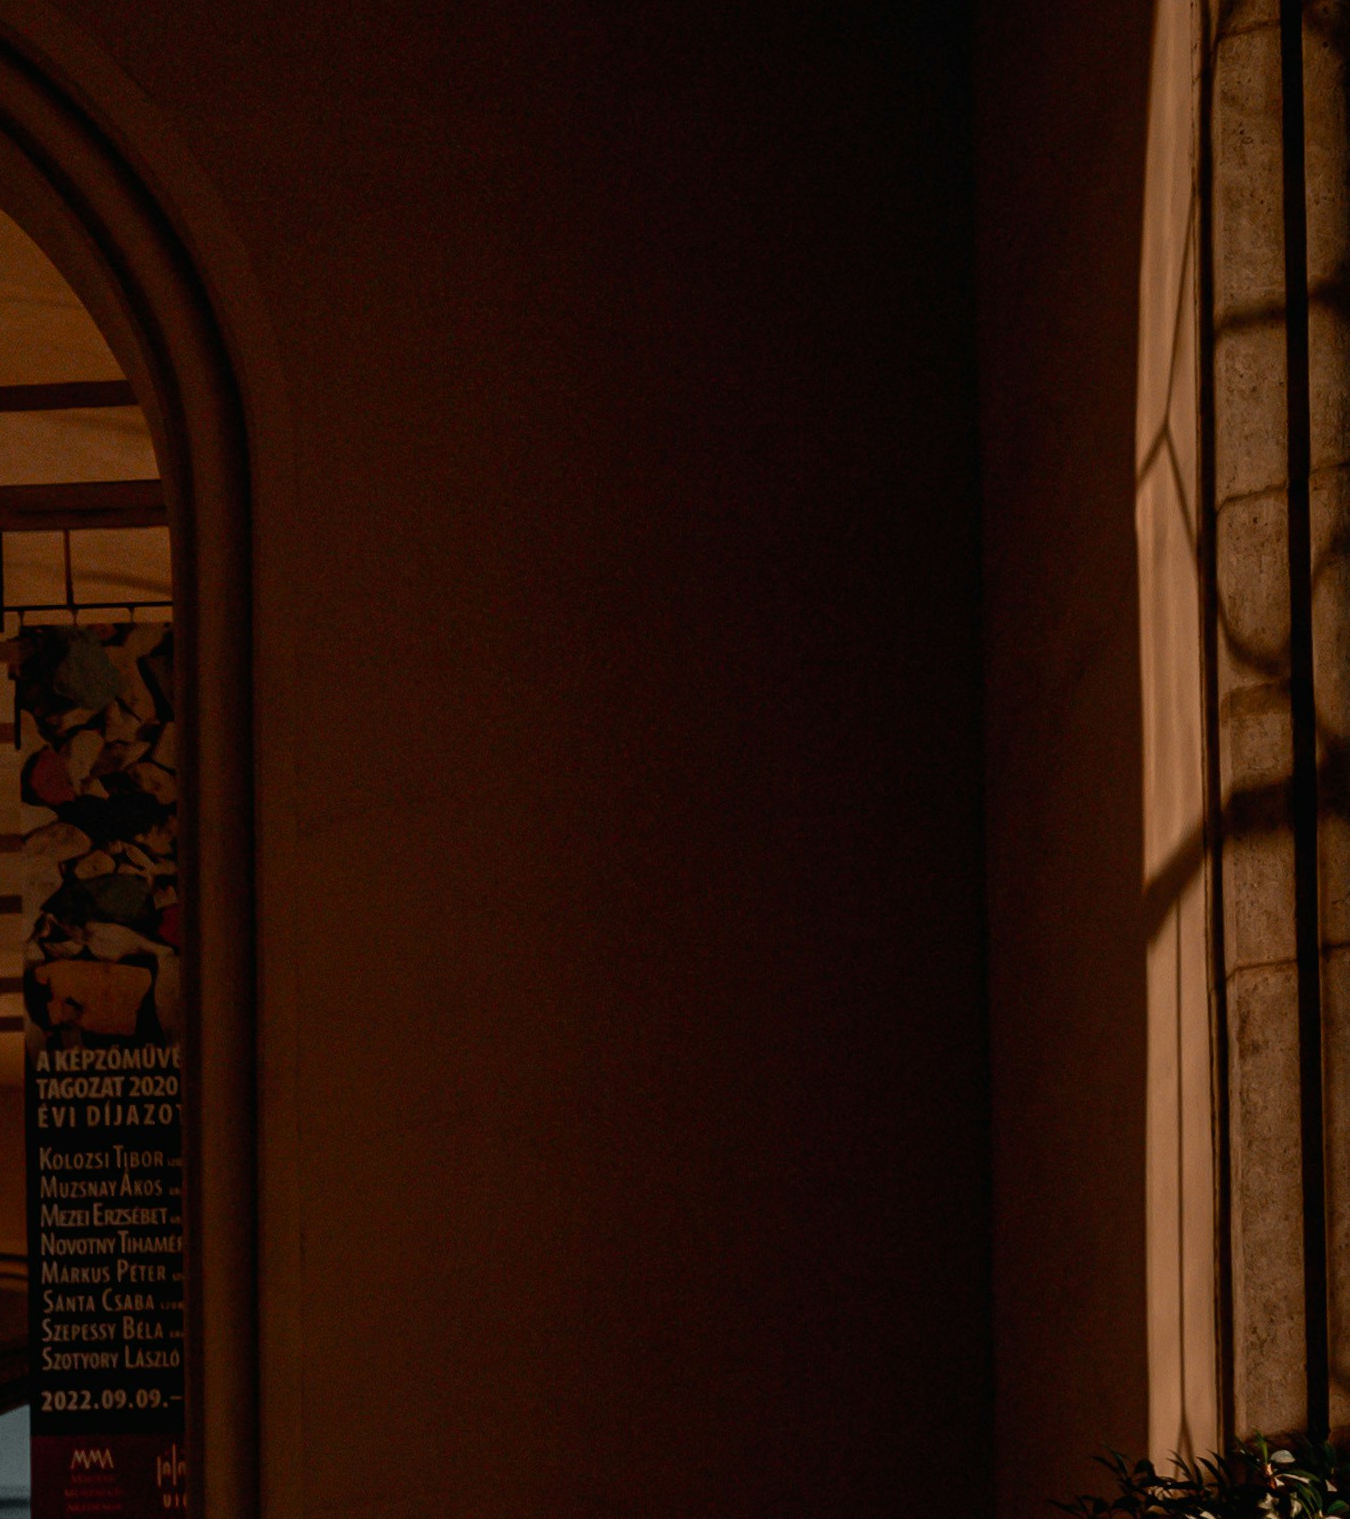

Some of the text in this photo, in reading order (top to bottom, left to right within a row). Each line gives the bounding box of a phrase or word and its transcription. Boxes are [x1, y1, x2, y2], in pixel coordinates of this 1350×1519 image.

[36, 1049, 50, 1072] A
[35, 1075, 180, 1100] TAGOZAT 2020
[37, 1102, 75, 1129] ÉVI
